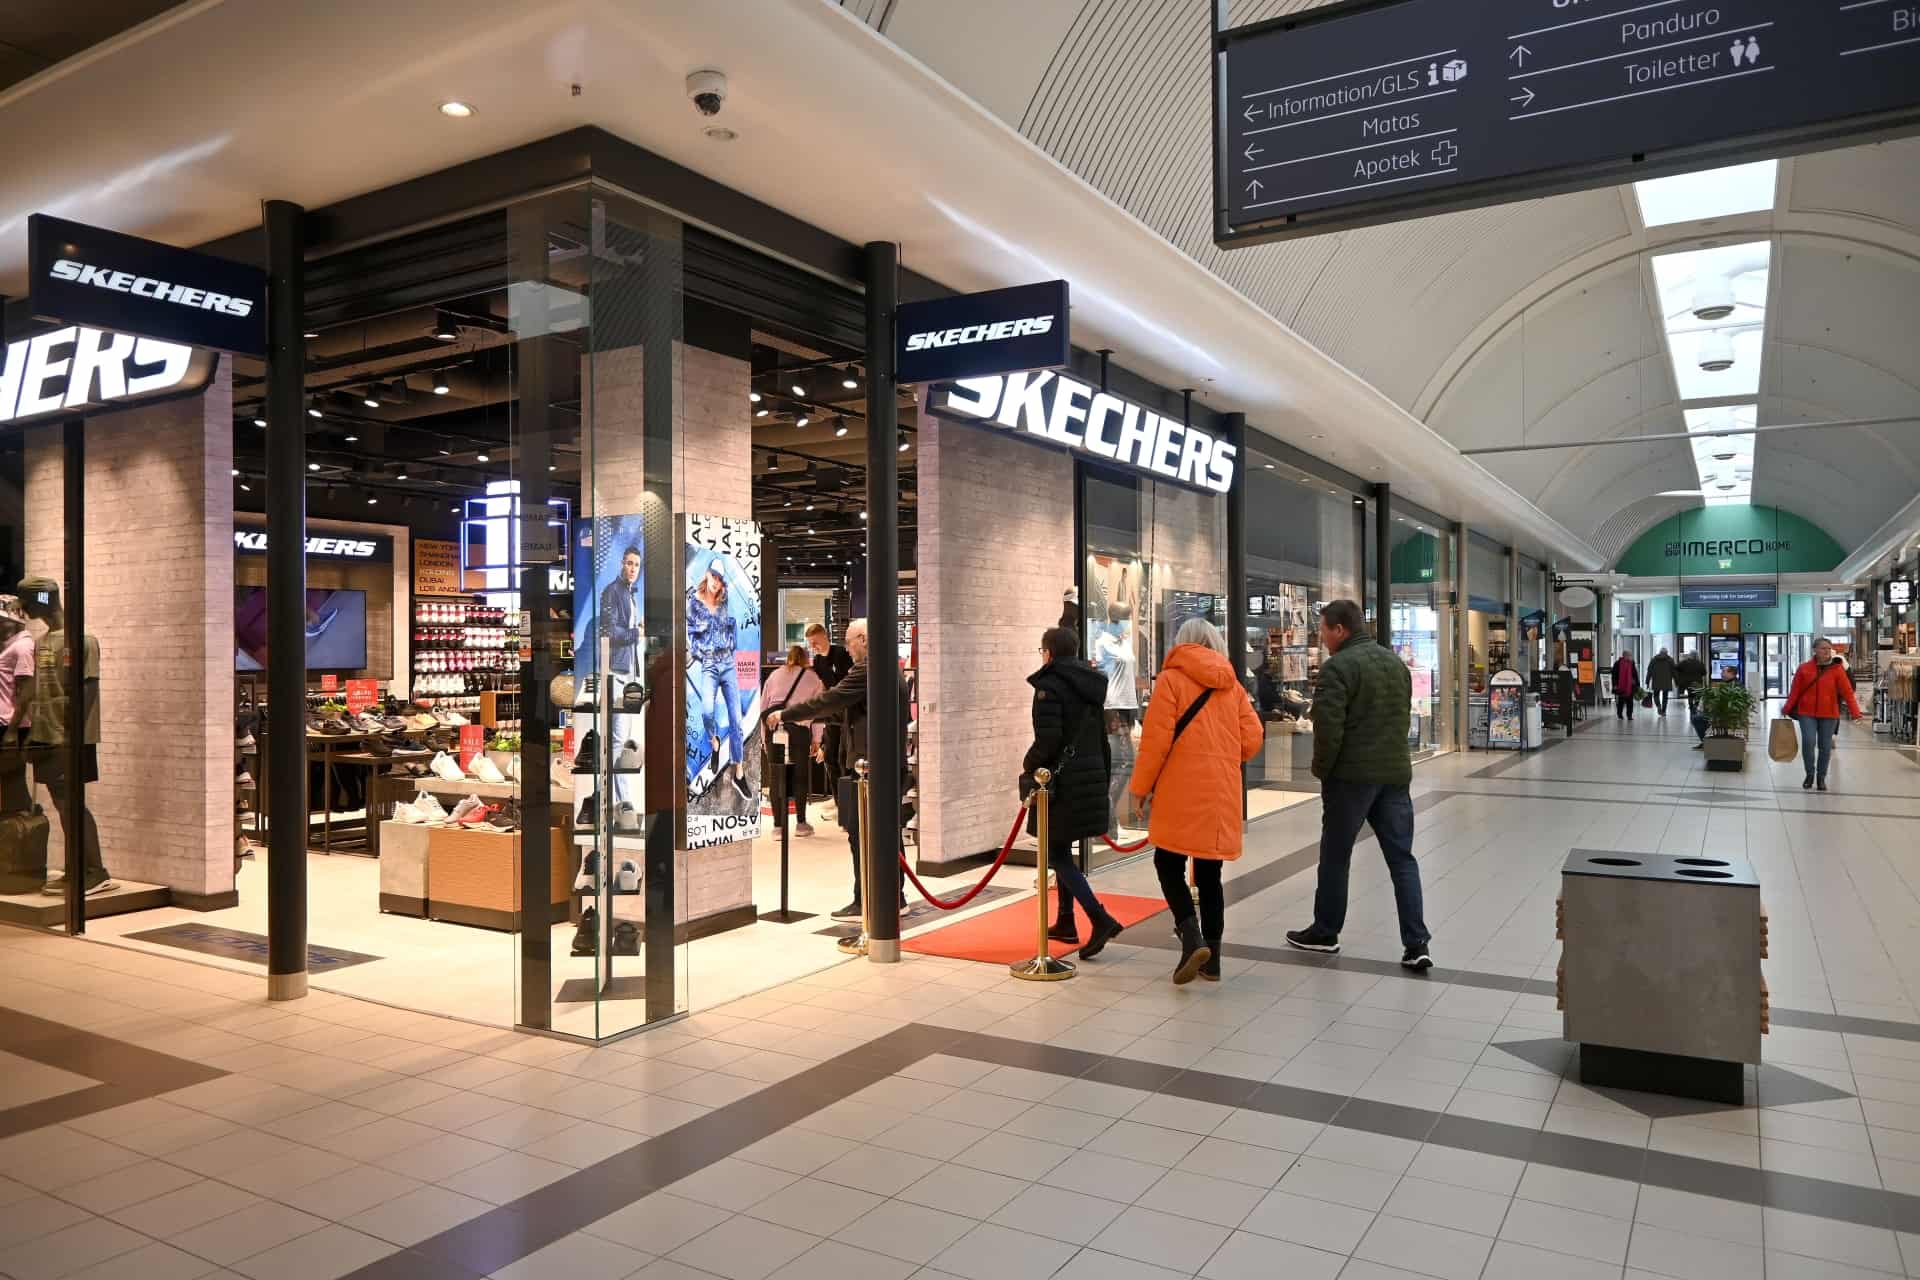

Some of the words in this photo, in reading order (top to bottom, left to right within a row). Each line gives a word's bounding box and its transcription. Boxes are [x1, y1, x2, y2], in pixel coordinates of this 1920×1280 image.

[1621, 9, 1721, 43] Panduro
[1893, 7, 1920, 32] Bi
[1624, 52, 1721, 84] Toiletter
[1269, 70, 1420, 120] Information/GLS
[1363, 113, 1420, 136] Matas
[1354, 151, 1420, 179] Apotek
[50, 258, 254, 318] SKECHERS
[906, 315, 1054, 352] SKECHERS
[946, 370, 1237, 493] SKECHERS
[1683, 539, 1764, 556] IMERCO
